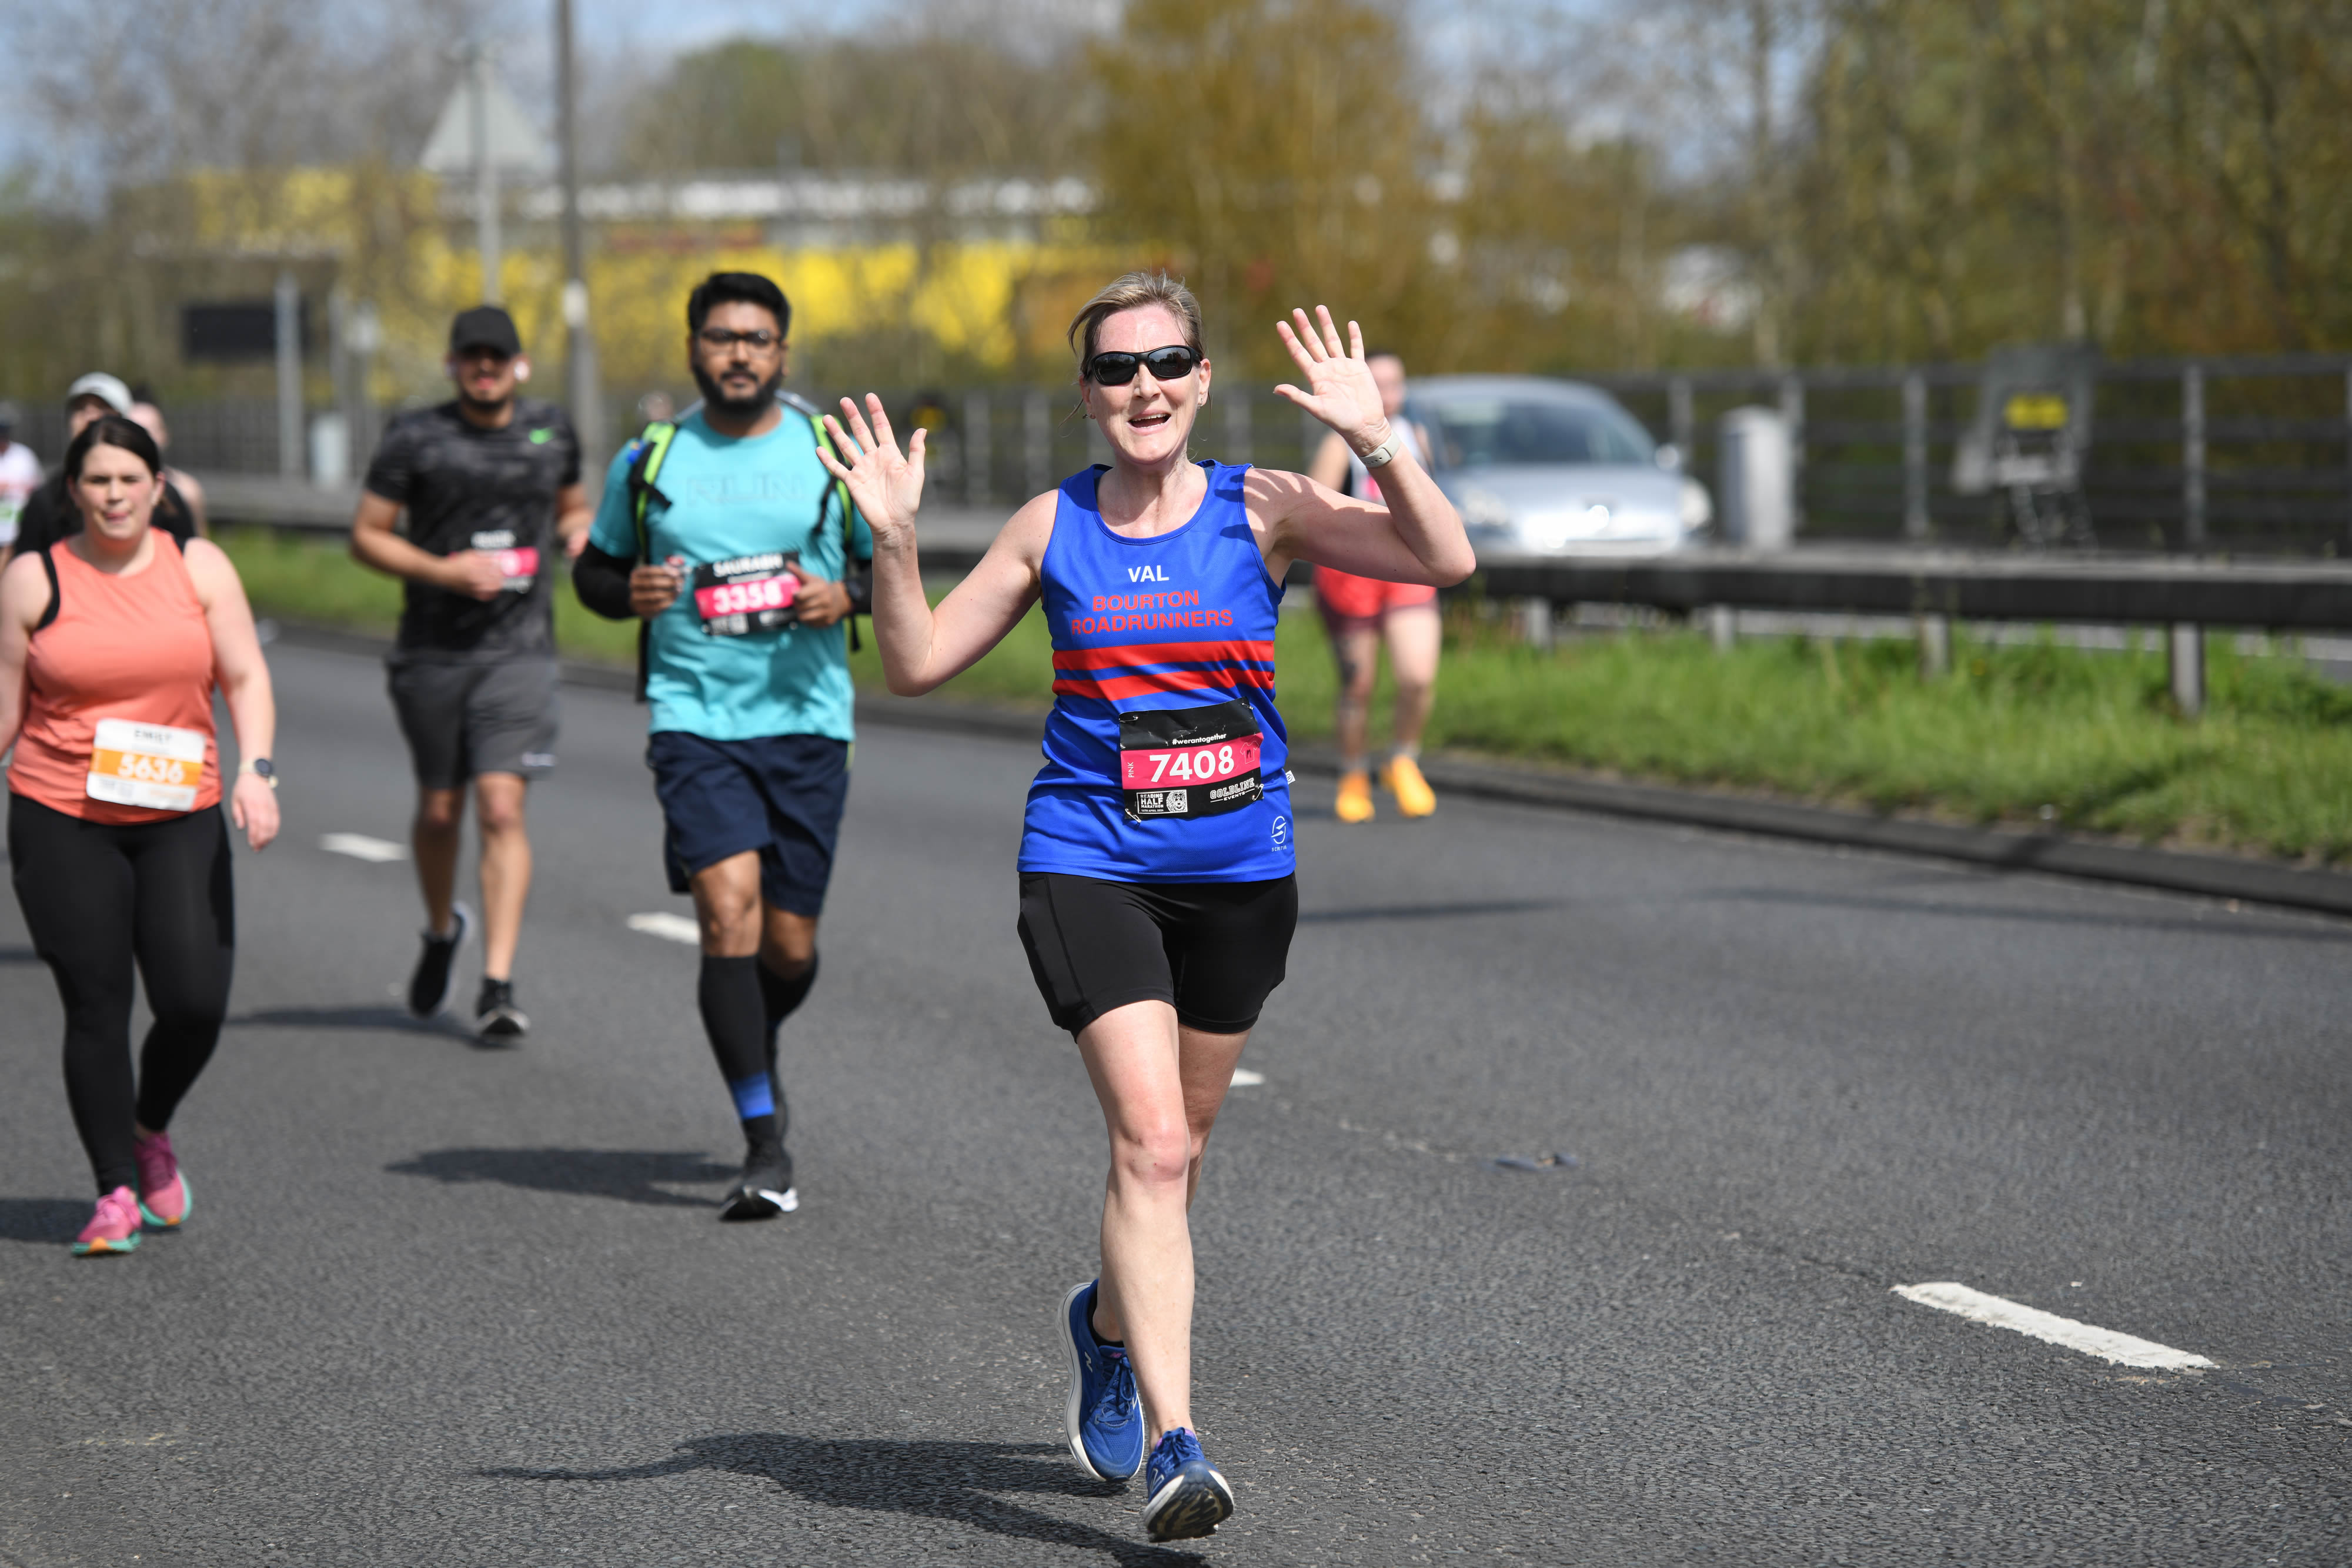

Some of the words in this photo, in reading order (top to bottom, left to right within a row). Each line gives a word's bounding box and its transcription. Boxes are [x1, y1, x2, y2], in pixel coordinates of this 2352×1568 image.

[686, 472, 806, 506] RUN
[1128, 565, 1170, 582] VAL
[713, 580, 783, 613] 3358
[1093, 590, 1199, 611] BOURTON
[1071, 609, 1234, 635] ROADRUNNERS
[1172, 733, 1227, 745] #werantogether
[118, 753, 184, 784] 5636
[1149, 745, 1234, 783] 7408
[1210, 777, 1255, 800] GOLDLINE
[1224, 791, 1245, 801] EVENTS
